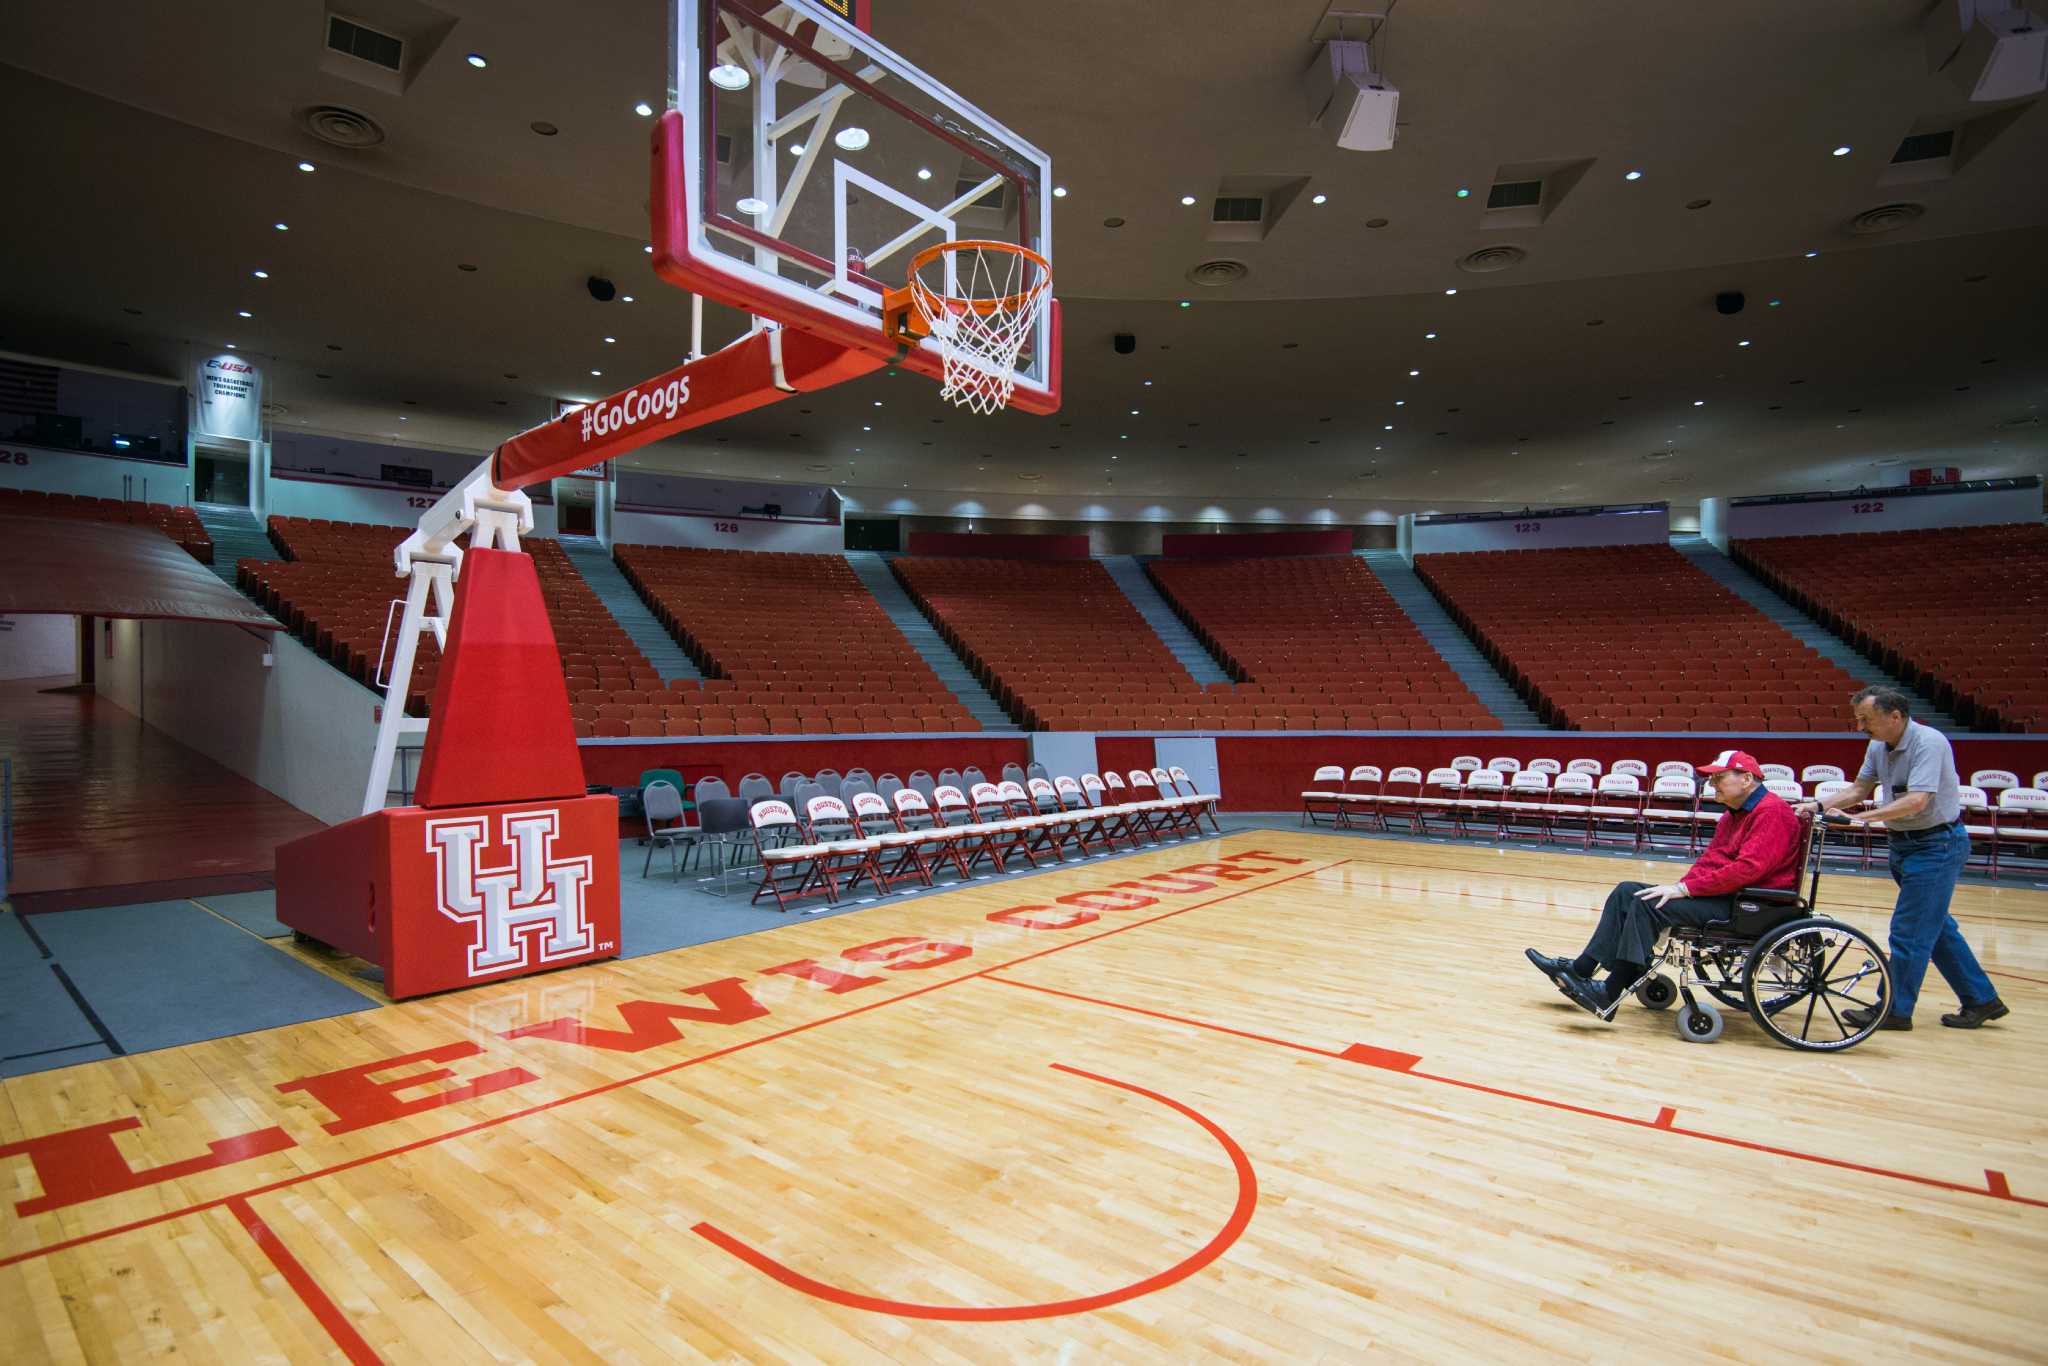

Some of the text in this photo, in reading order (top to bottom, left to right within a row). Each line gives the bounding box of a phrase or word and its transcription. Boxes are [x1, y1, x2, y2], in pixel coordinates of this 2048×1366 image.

[581, 375, 691, 443] #GoCoogs
[0, 450, 29, 466] 28
[407, 496, 438, 509] 127
[1852, 502, 1885, 514] 122
[713, 522, 738, 534] 126
[1514, 522, 1541, 534] 123
[813, 801, 843, 813] HOUSTON
[858, 797, 883, 808] HOUSTON
[757, 805, 789, 819] HOUSTON
[425, 808, 596, 978] UH
[0, 851, 1303, 1219] LEWIS COURT
